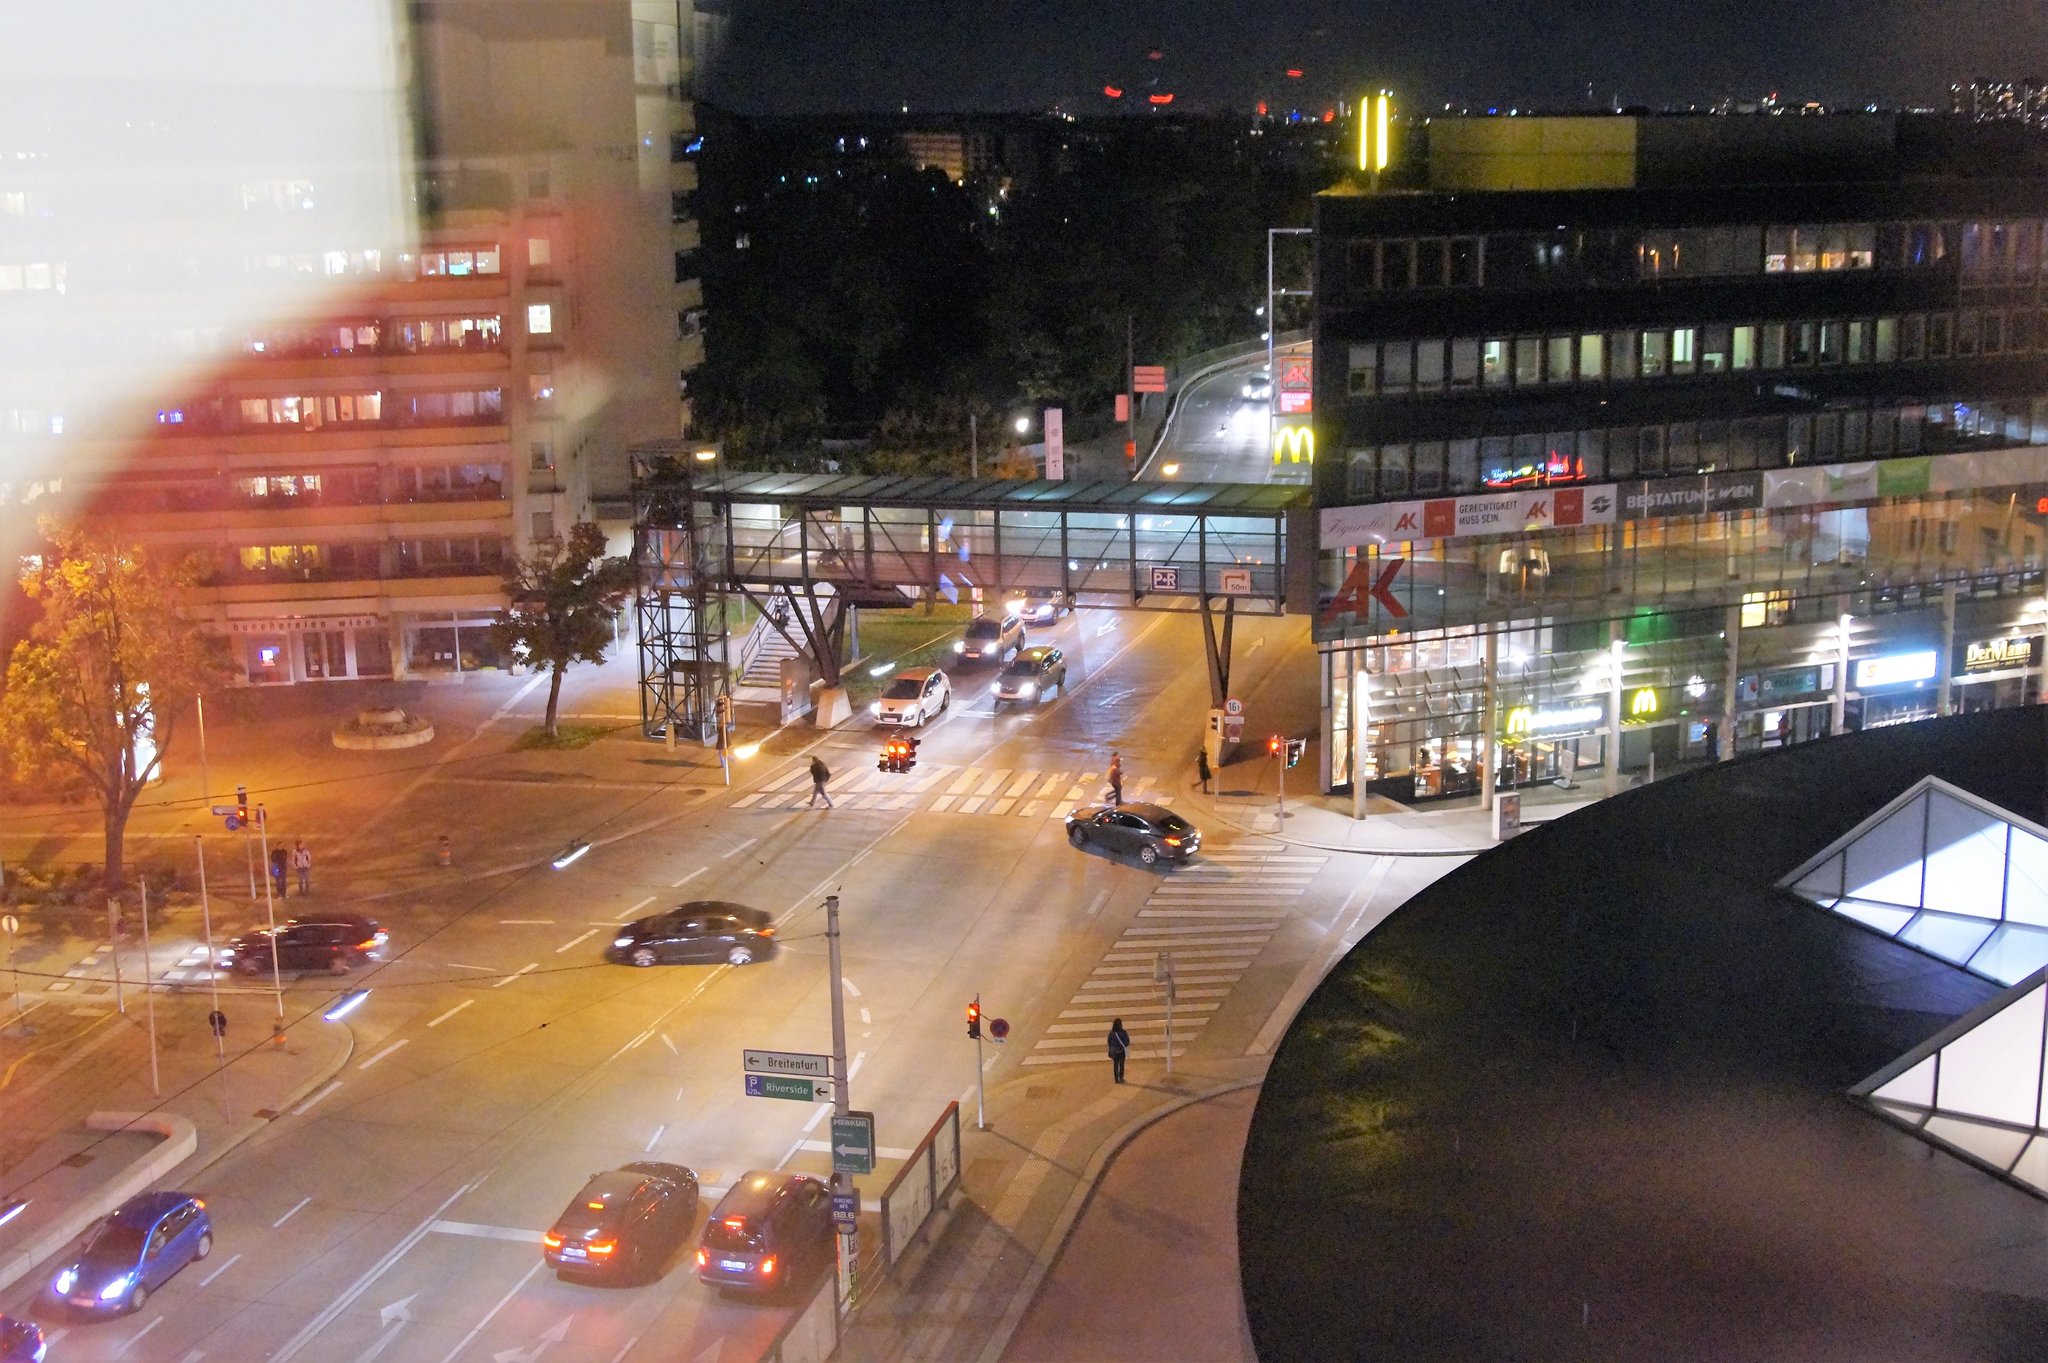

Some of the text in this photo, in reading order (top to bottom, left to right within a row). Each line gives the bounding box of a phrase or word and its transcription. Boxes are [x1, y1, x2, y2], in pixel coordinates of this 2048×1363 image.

[1283, 366, 1309, 383] AK
[1627, 485, 1754, 509] BESTATTUNG WIEN
[1459, 500, 1518, 514] GERECHTIGKEIT
[1525, 501, 1548, 520] AK
[1394, 512, 1417, 532] AK
[1459, 514, 1480, 525] MUSS
[1320, 557, 1409, 629] AK
[1966, 640, 2031, 662] DerMann
[767, 1056, 819, 1071] Breitenfurt
[766, 1082, 809, 1095] Riverside
[833, 1118, 867, 1127] MERKUR
